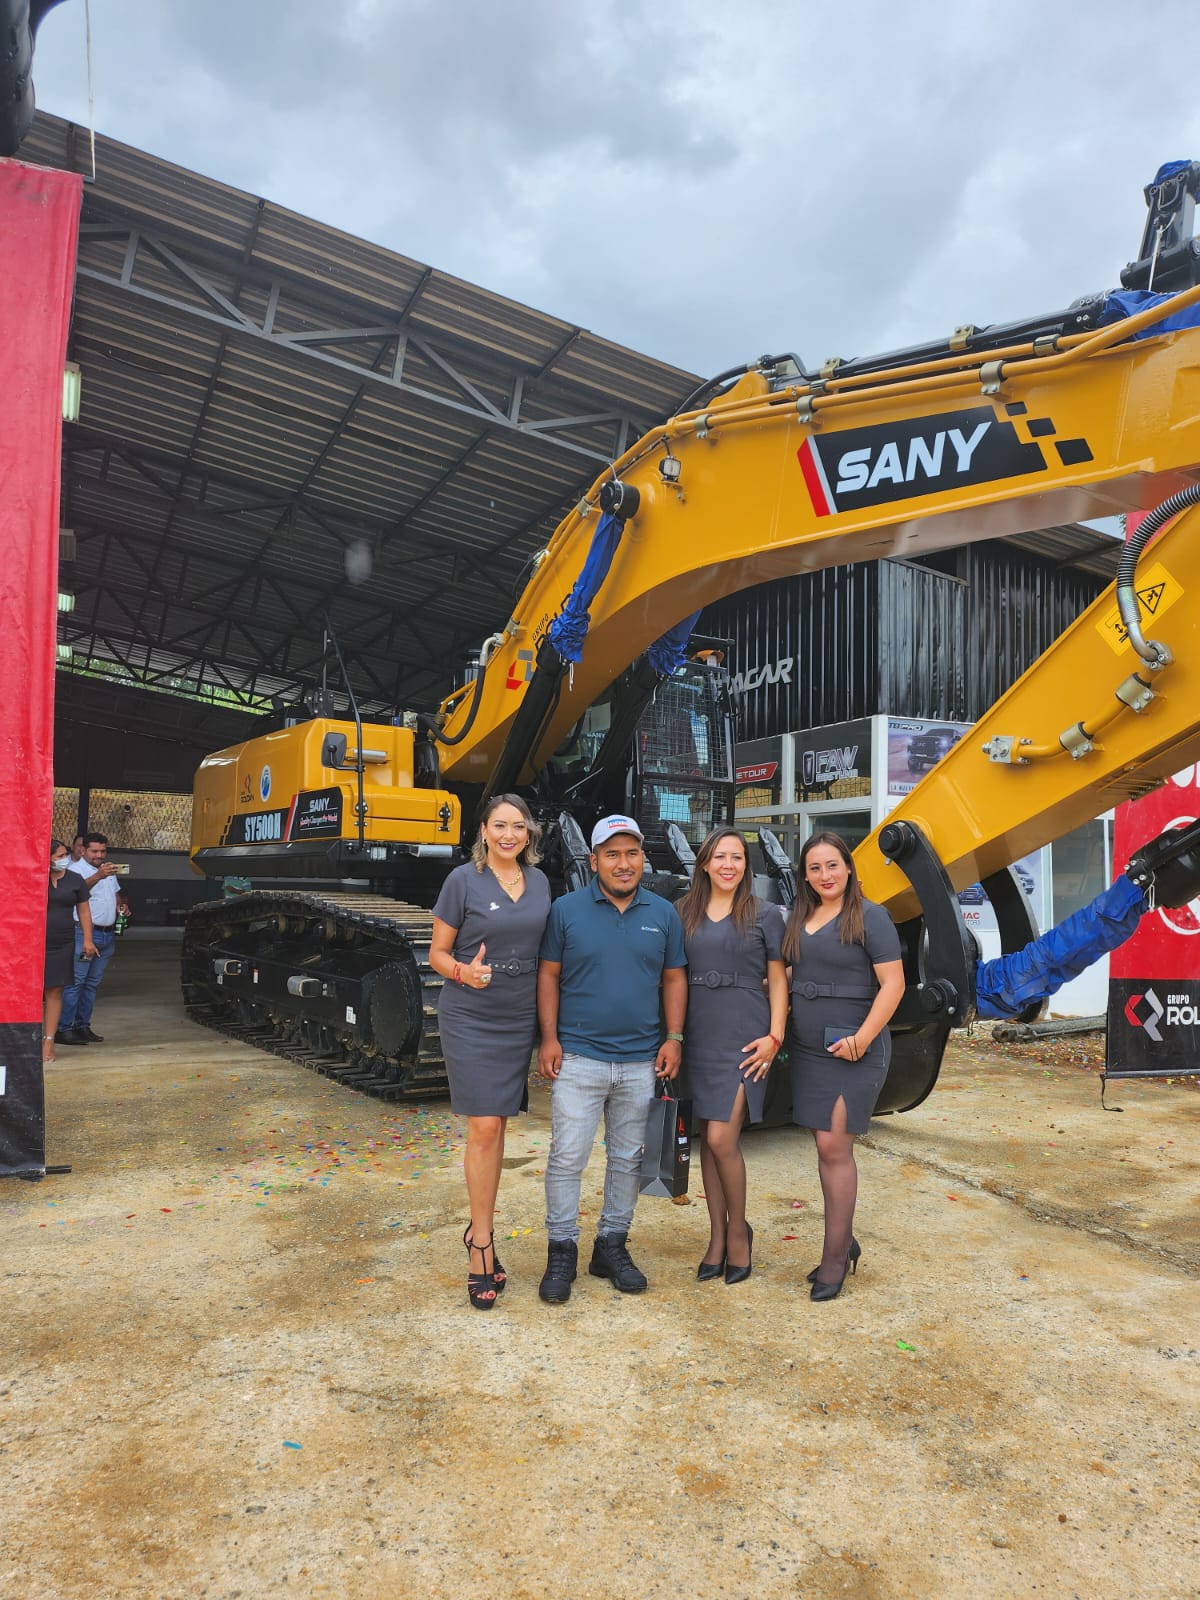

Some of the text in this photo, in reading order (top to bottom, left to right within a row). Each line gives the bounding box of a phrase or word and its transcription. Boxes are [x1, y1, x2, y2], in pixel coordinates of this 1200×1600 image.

[836, 421, 993, 494] SANY
[815, 745, 859, 774] FAW
[736, 768, 767, 779] ETOUR
[310, 797, 330, 812] SANY
[1167, 994, 1190, 1005] GRUPO
[1166, 1006, 1200, 1026] ROL
